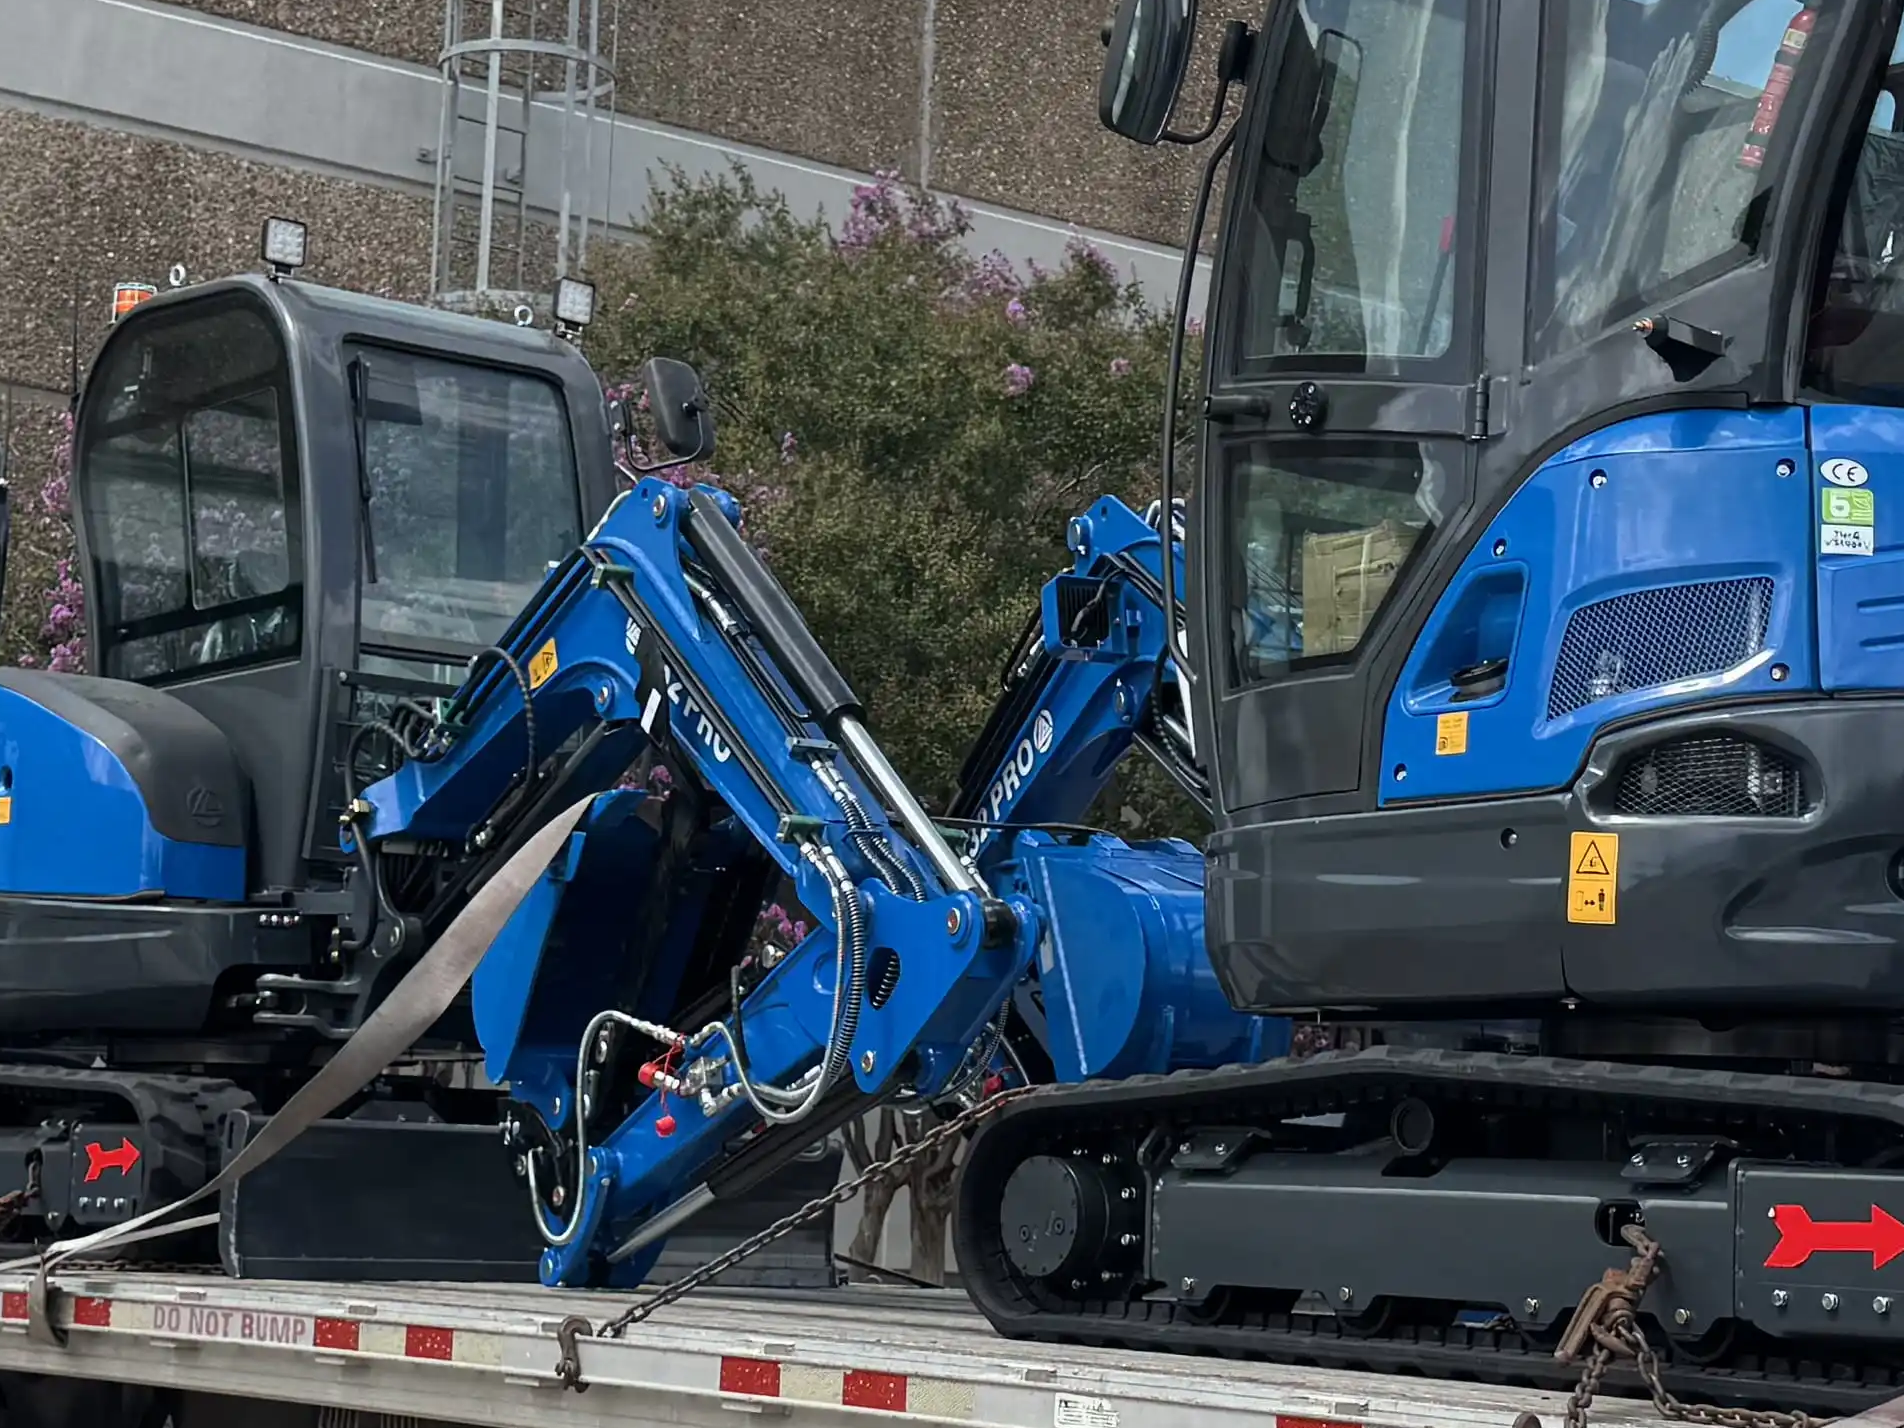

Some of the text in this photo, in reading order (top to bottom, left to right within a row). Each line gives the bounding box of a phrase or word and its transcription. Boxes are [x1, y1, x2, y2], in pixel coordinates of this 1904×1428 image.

[990, 738, 1034, 821] PRO
[153, 1305, 307, 1345] DO NOT BUMP
